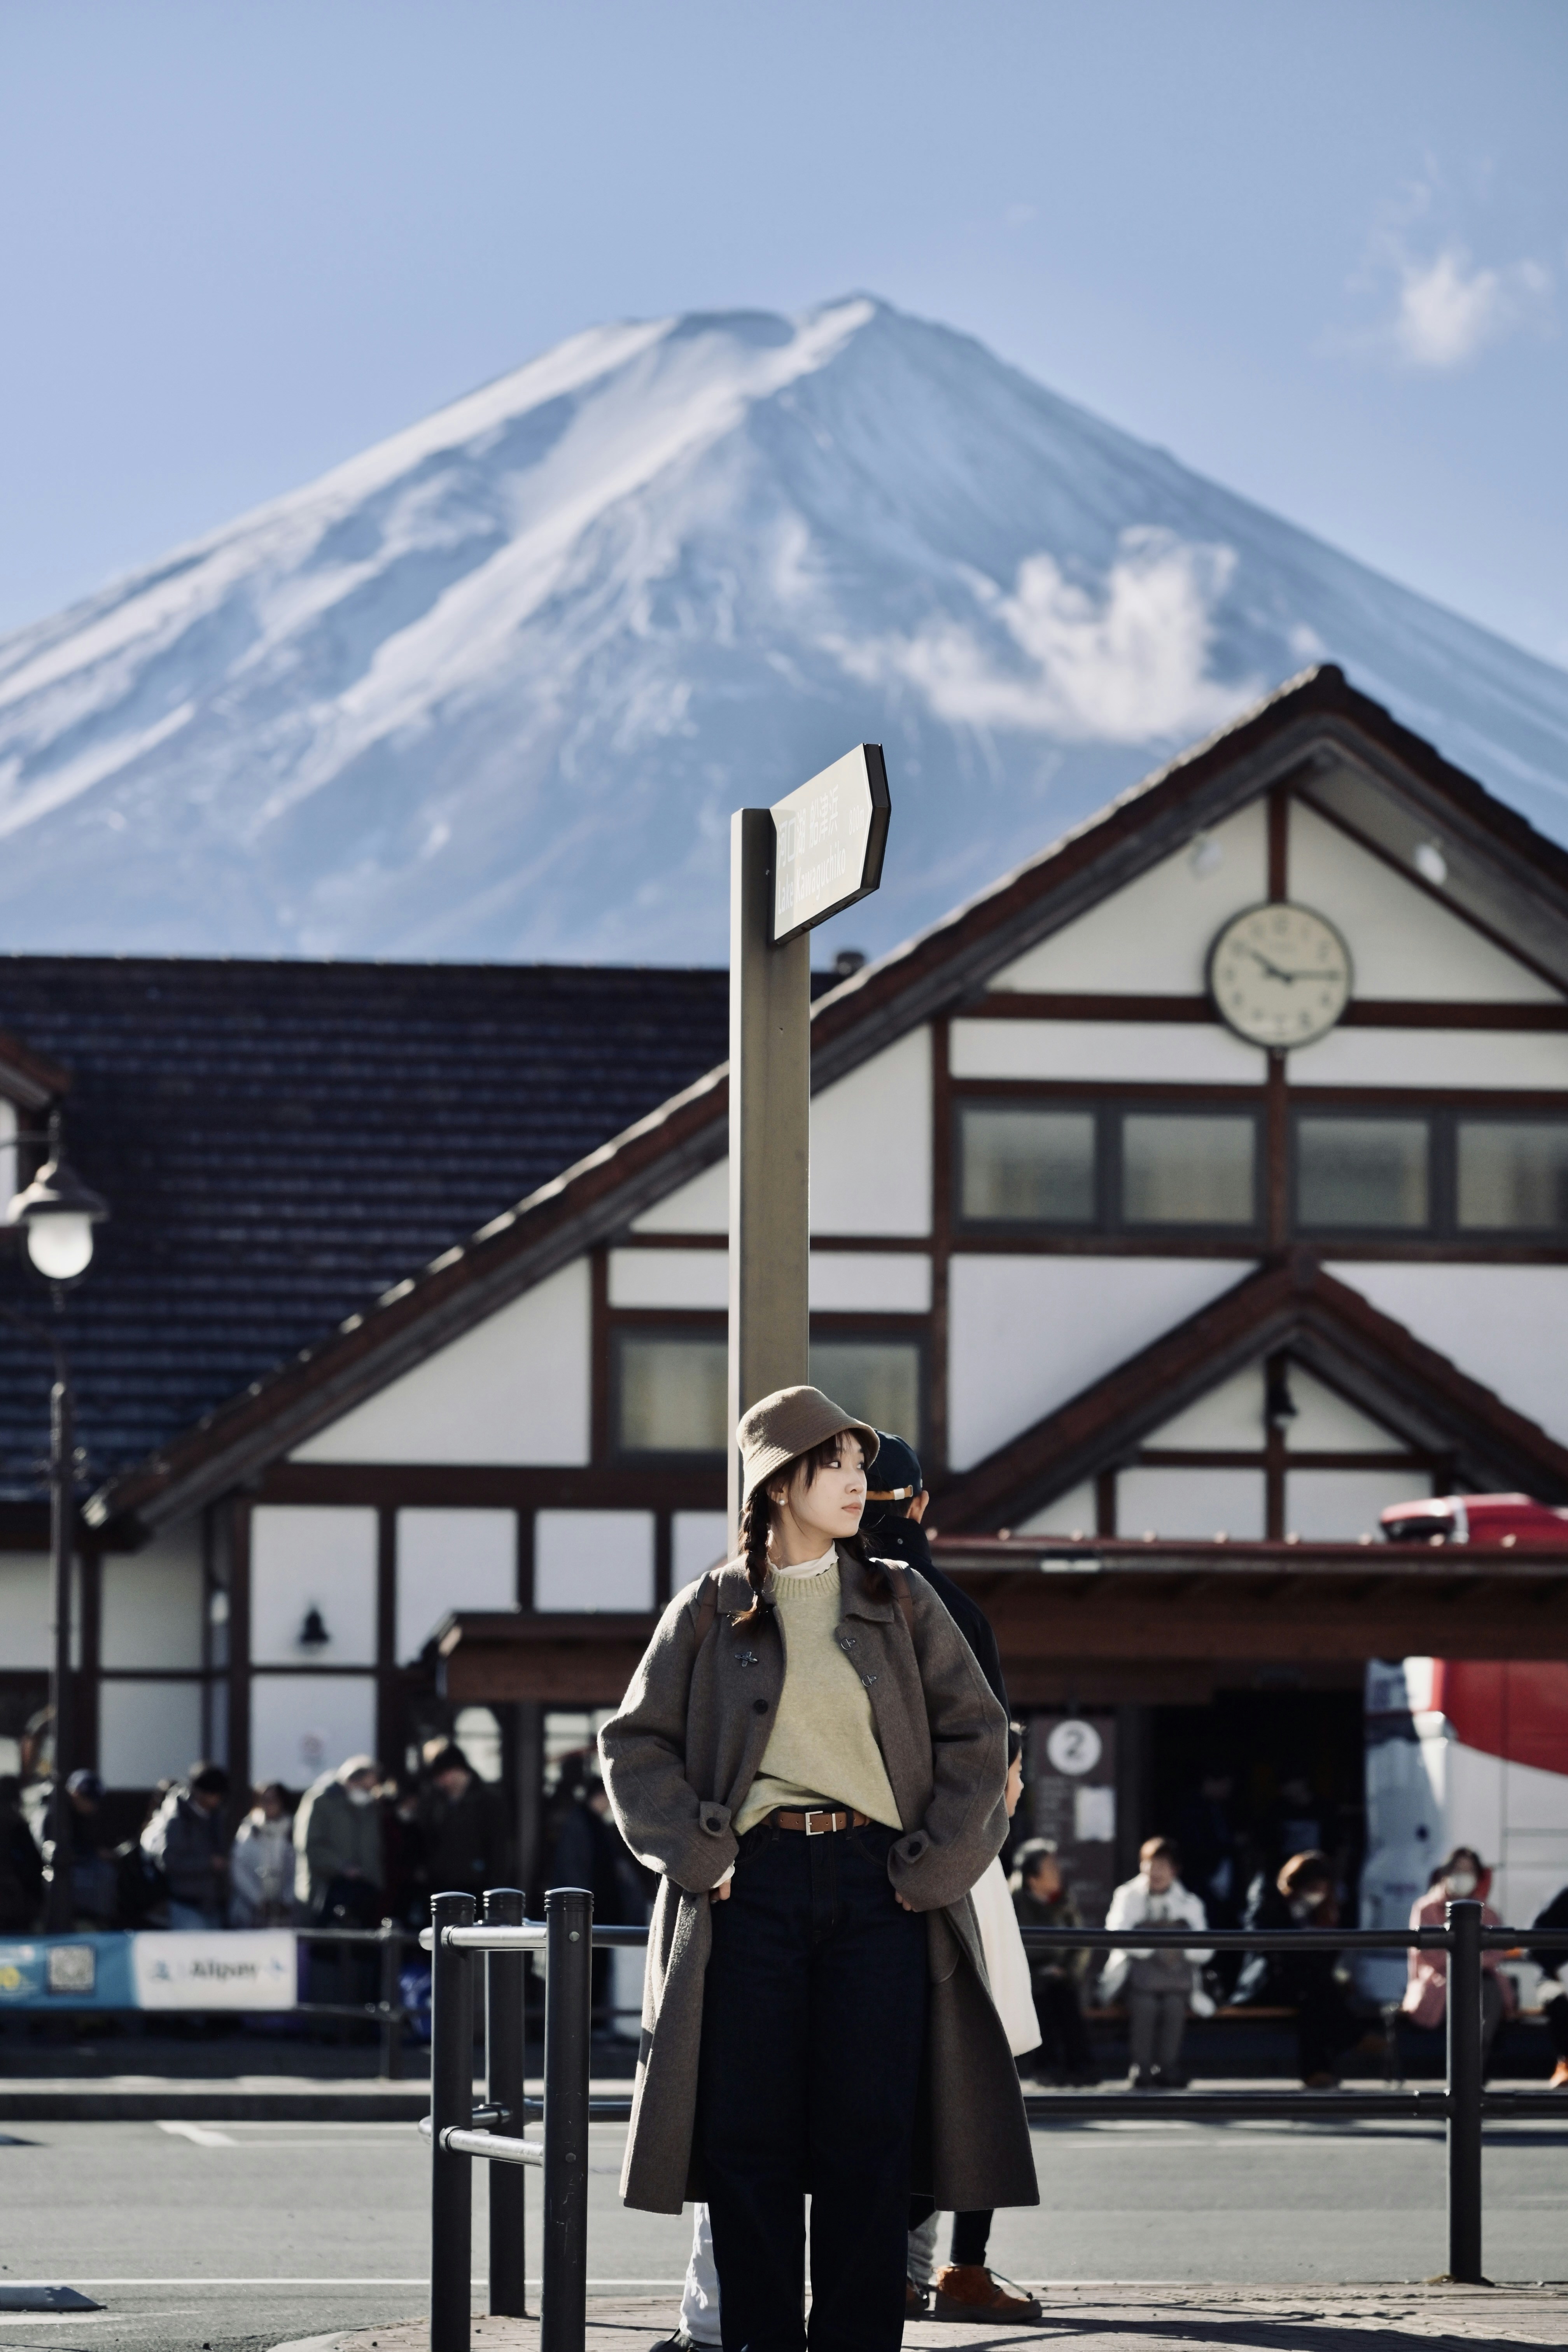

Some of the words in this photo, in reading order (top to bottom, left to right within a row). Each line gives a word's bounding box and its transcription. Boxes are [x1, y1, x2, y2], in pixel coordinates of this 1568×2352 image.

[778, 807, 806, 870] 河口湖
[809, 784, 838, 849] 船津浜
[849, 805, 864, 836] 800m
[778, 874, 794, 915] Lake
[796, 840, 846, 903] Kawaguchiko
[1065, 1729, 1085, 1761] 2
